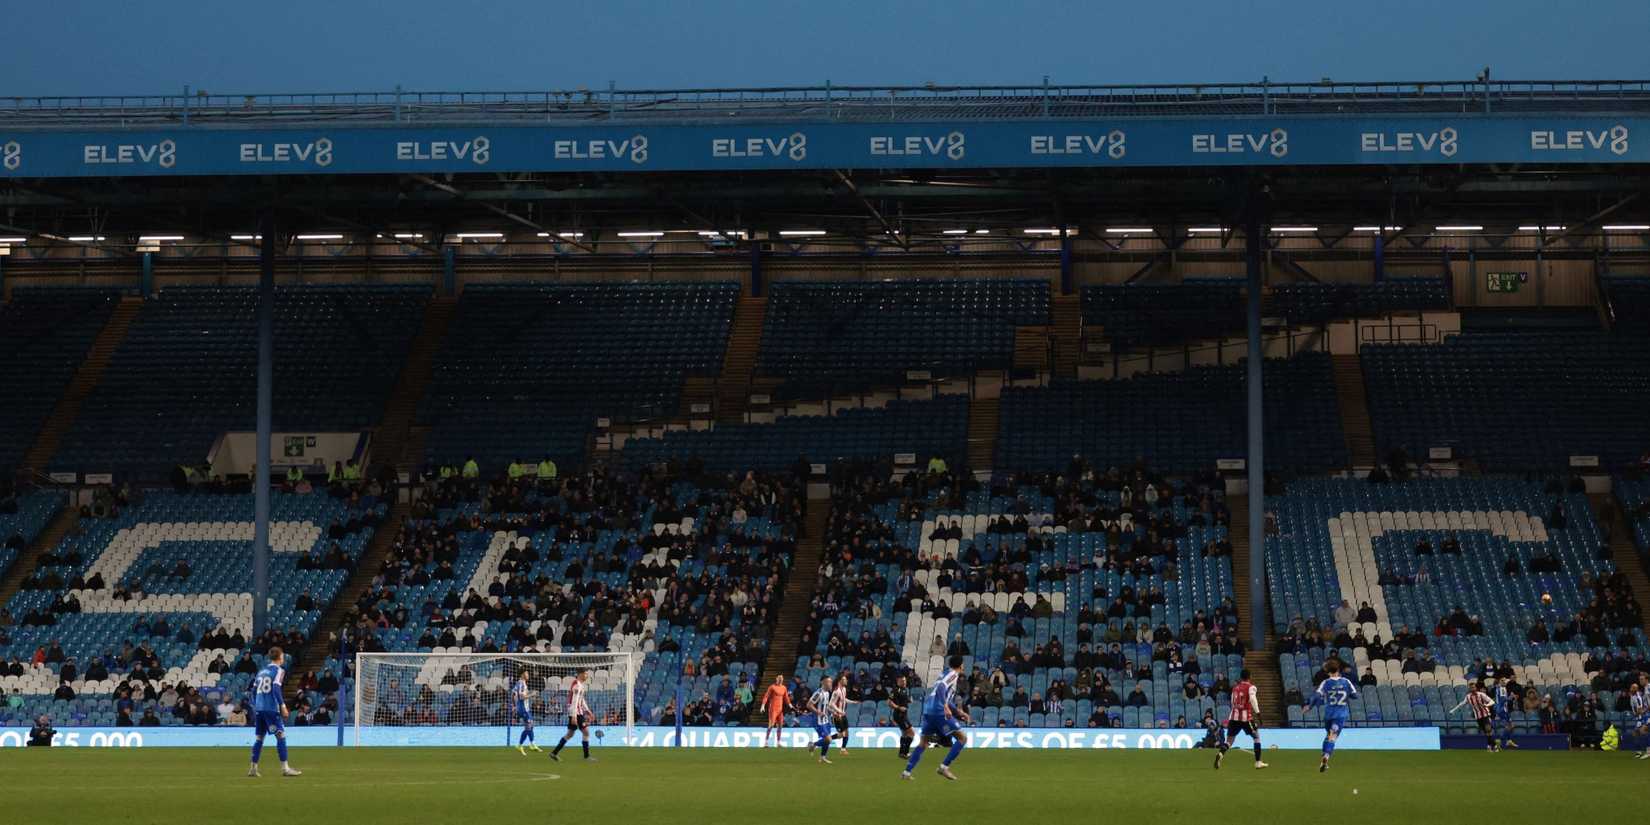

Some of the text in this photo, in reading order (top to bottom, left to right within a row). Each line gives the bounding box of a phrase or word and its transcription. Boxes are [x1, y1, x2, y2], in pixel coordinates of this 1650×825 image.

[84, 139, 176, 169] ELEV8
[240, 137, 333, 167] ELEV8
[396, 136, 490, 165] ELEV8
[554, 135, 648, 164] ELEV8
[712, 132, 807, 161] ELEV8
[870, 131, 965, 161] ELEV8
[1030, 130, 1126, 160] ELEV8
[1192, 129, 1288, 158] ELEV8
[1361, 127, 1458, 158] ELEV8
[1531, 125, 1629, 156] ELEV8
[255, 676, 272, 694] 28
[1327, 690, 1348, 706] 32
[50, 732, 143, 747] £5000
[1041, 731, 1085, 748] OF
[1091, 733, 1193, 748] £5000
